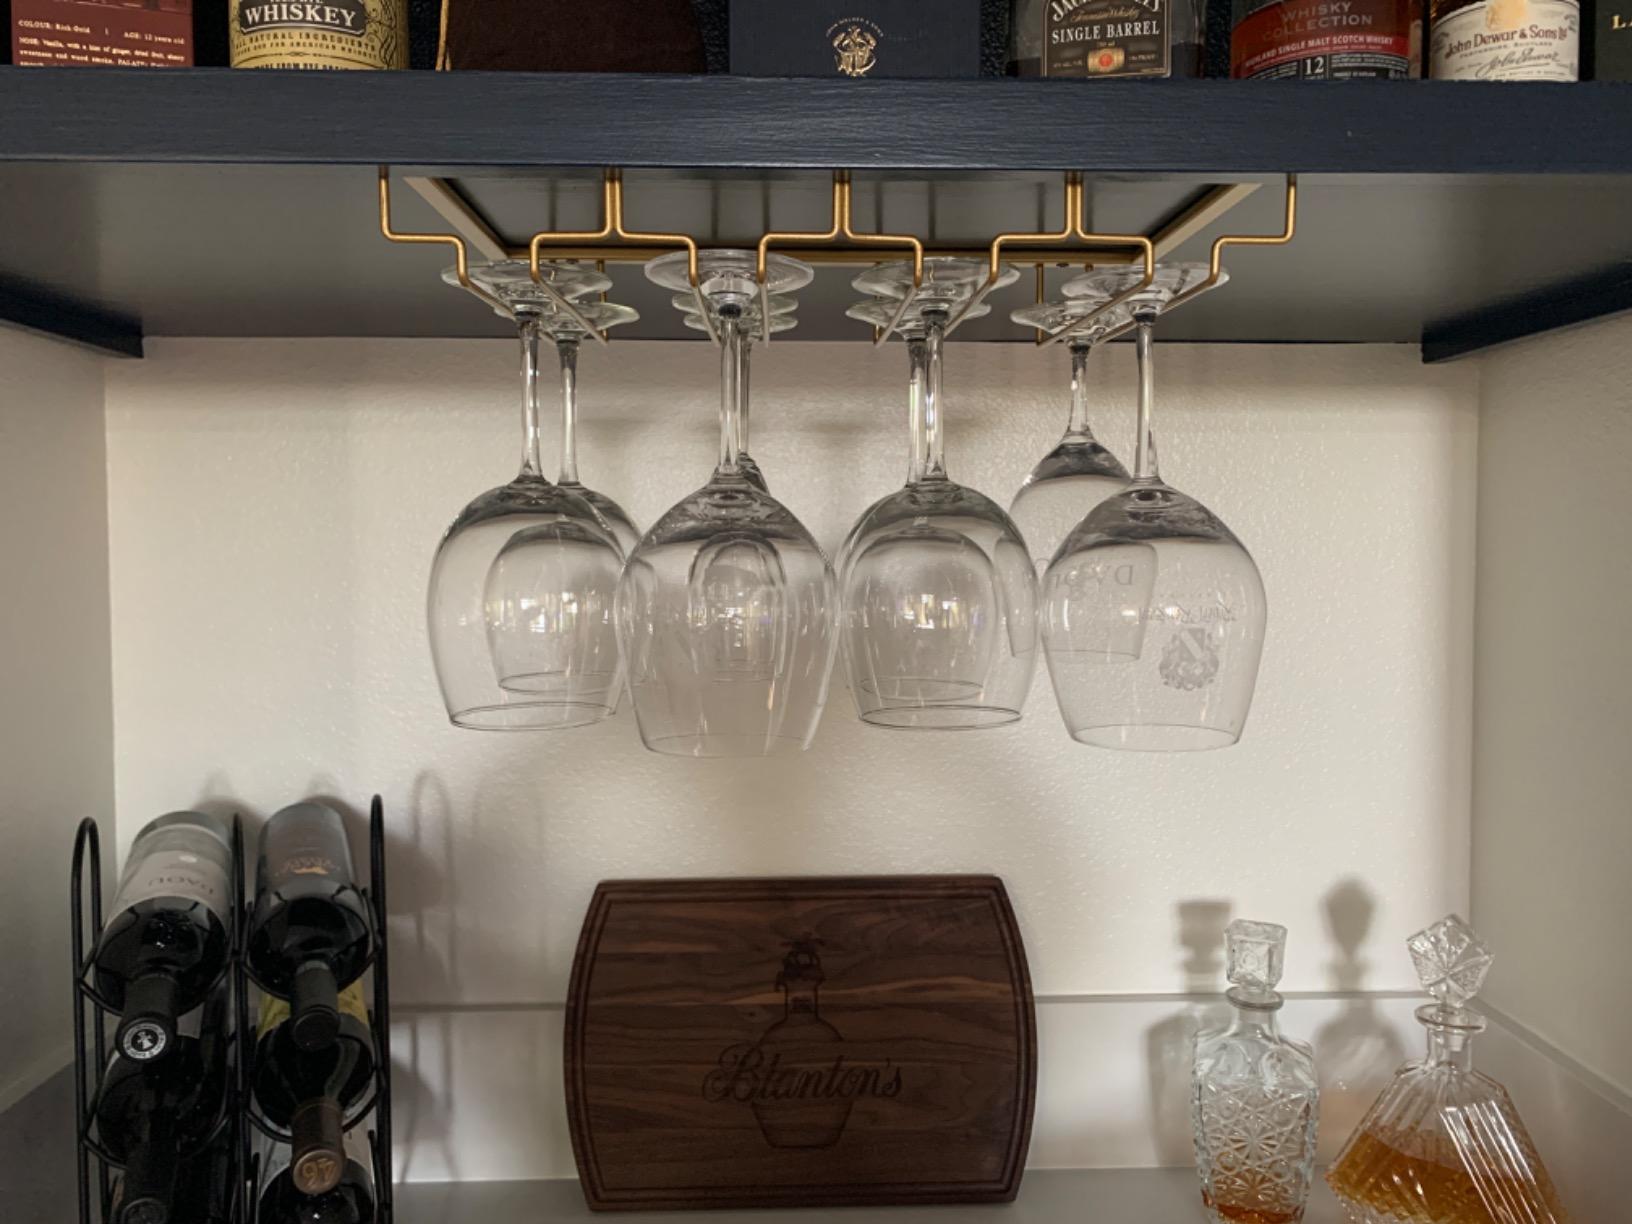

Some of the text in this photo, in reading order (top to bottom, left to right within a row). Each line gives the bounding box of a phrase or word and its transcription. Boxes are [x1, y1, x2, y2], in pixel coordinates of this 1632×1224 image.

[245, 3, 356, 27] WHISKEY
[1281, 1, 1352, 22] WHISKY
[1611, 14, 1632, 29] L
[18, 19, 53, 29] COLOUR:
[1052, 21, 1161, 44] SINGLE BARREL
[1264, 14, 1373, 41] COLLECTION
[249, 32, 293, 44] NATURAL
[299, 32, 375, 52] INGREDIENTS
[1278, 40, 1305, 54] SINGLE
[1307, 37, 1329, 47] MALT
[1332, 35, 1364, 45] SCOTCH
[1365, 34, 1393, 46] WHISKY
[1445, 39, 1472, 59] John
[1473, 29, 1518, 47] Dewar
[1519, 29, 1528, 39] &
[1529, 24, 1558, 39] Sons
[1304, 56, 1325, 75] 12
[702, 1043, 902, 1101] Blanton's
